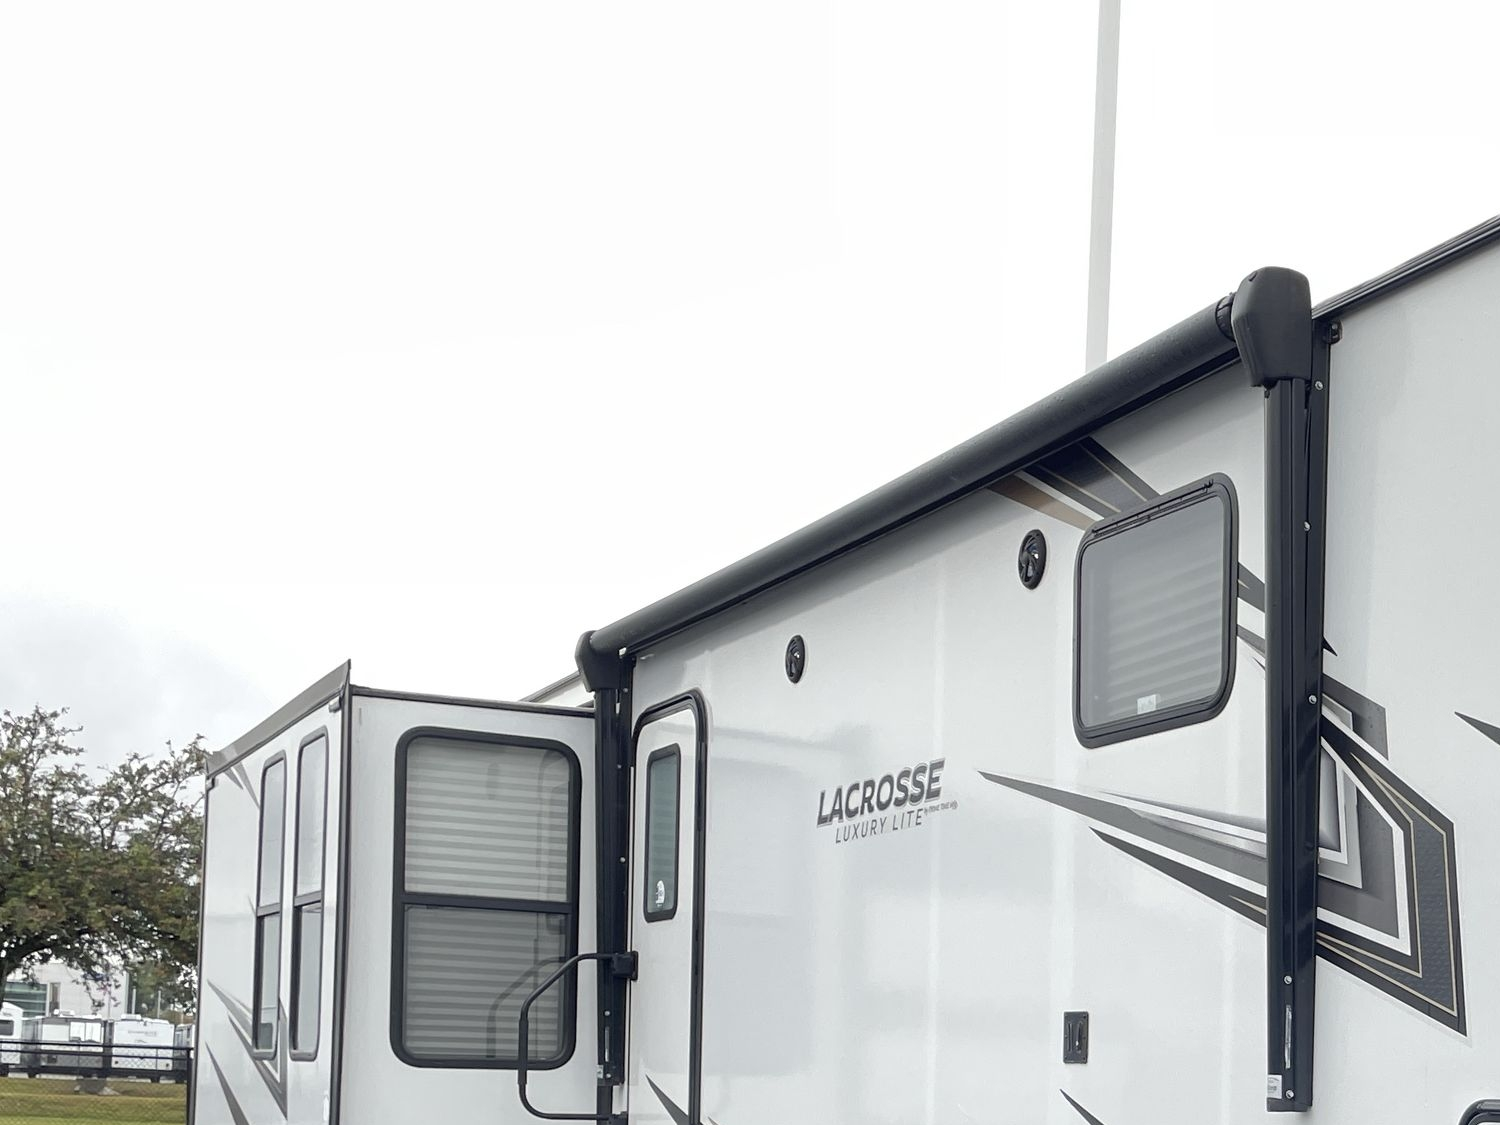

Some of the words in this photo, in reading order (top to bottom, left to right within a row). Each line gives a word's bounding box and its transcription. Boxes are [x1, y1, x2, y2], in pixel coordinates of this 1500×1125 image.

[817, 758, 945, 827] LACROSSE
[836, 816, 888, 844] LUXURY
[892, 808, 924, 831] LITE
